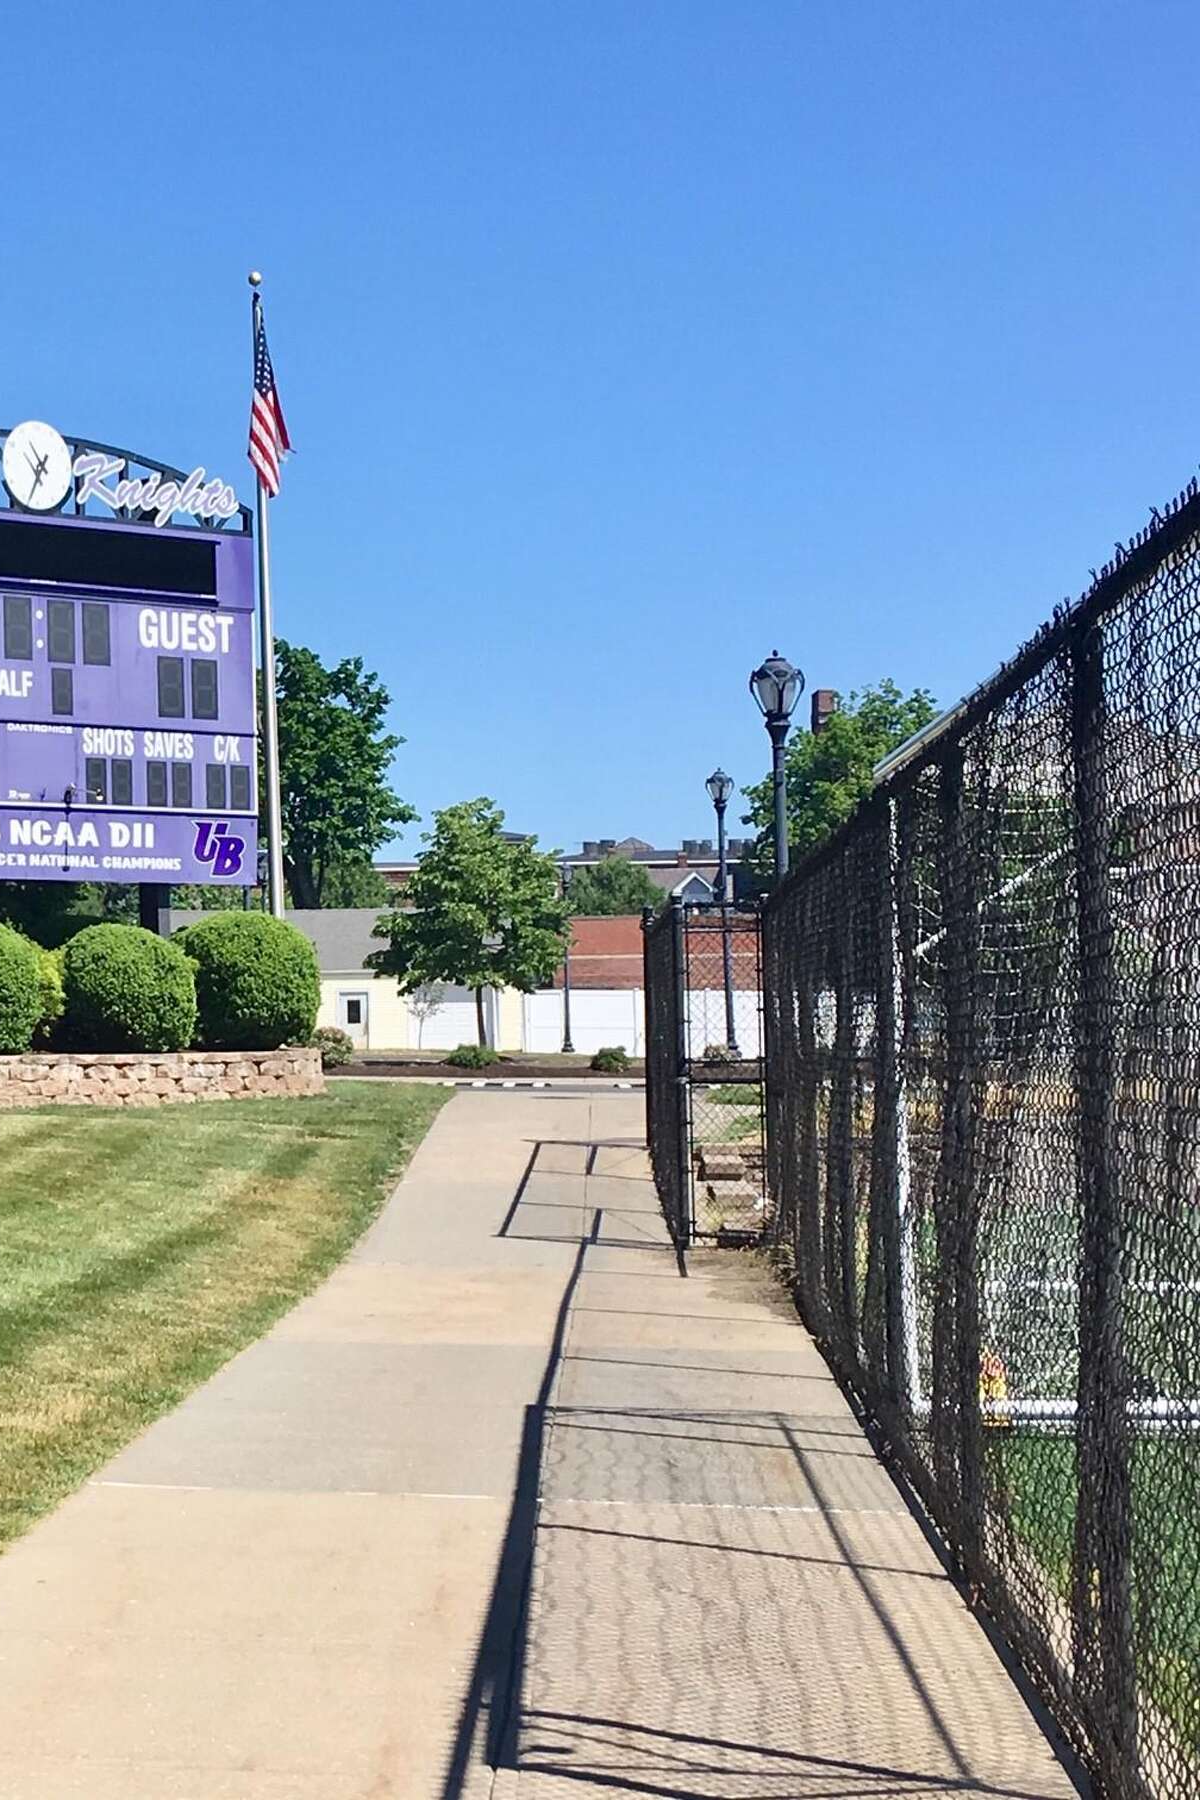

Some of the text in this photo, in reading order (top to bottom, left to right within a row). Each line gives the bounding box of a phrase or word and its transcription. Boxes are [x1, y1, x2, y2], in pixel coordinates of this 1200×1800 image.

[72, 453, 240, 528] Knights
[138, 608, 234, 653] GUEST
[82, 727, 241, 763] SHOTS SAVES C/K
[9, 819, 100, 848] NCAA
[108, 821, 155, 849] DII
[190, 819, 246, 879] UB
[102, 855, 183, 871] CHAMPIONS
